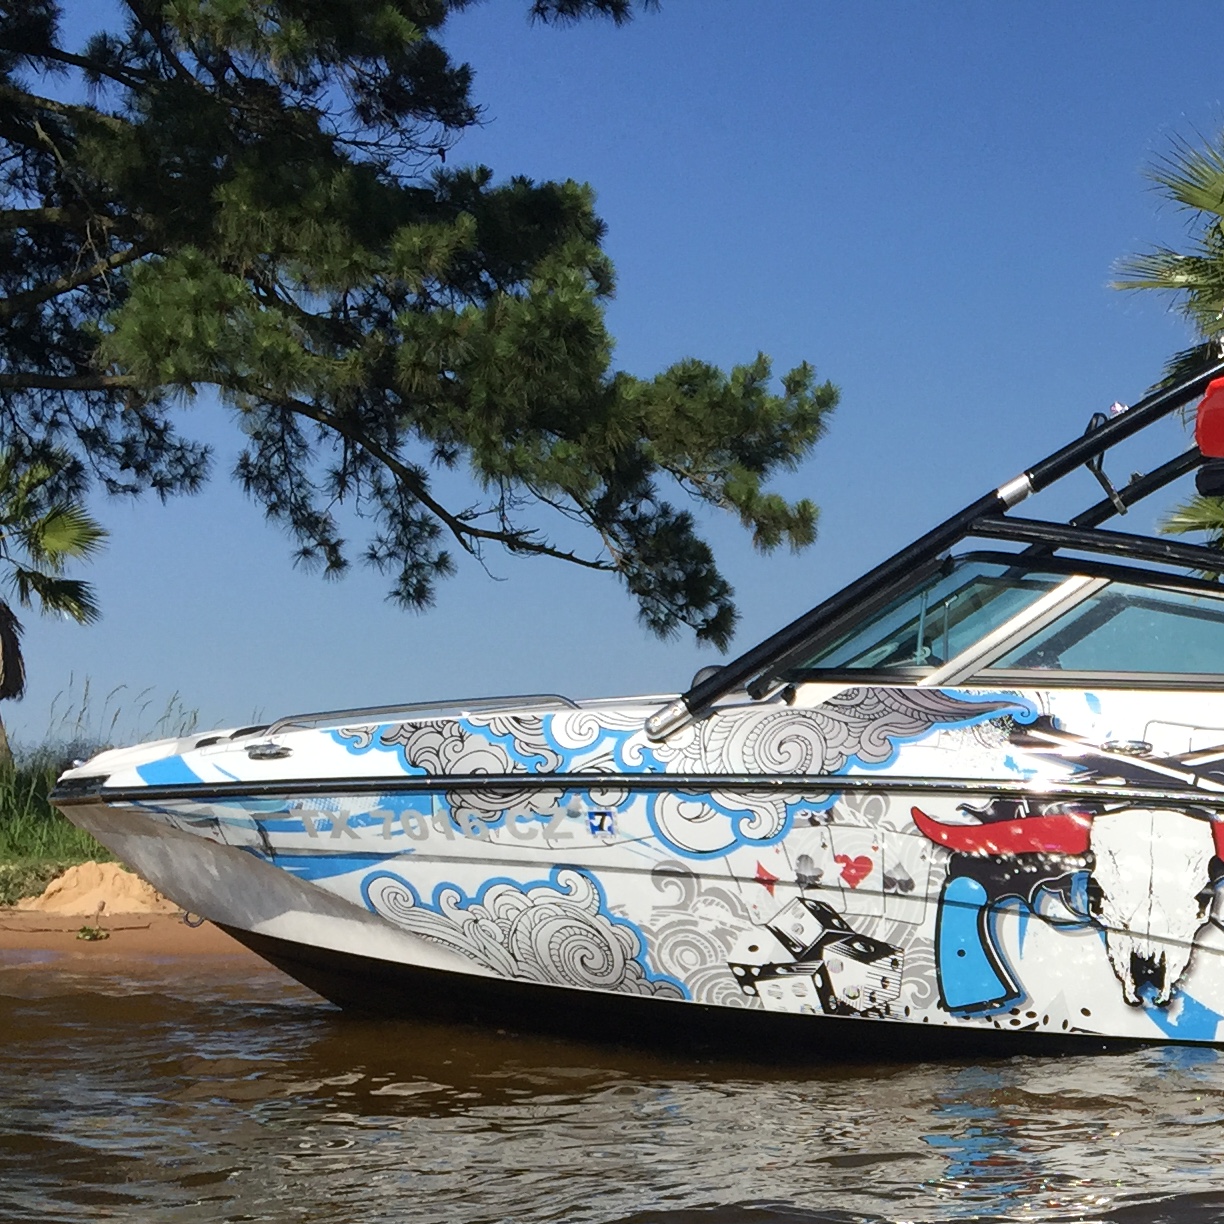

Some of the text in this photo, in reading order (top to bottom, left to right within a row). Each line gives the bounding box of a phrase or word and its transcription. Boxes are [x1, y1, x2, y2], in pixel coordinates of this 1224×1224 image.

[290, 807, 574, 841] TX 7016 CZ
